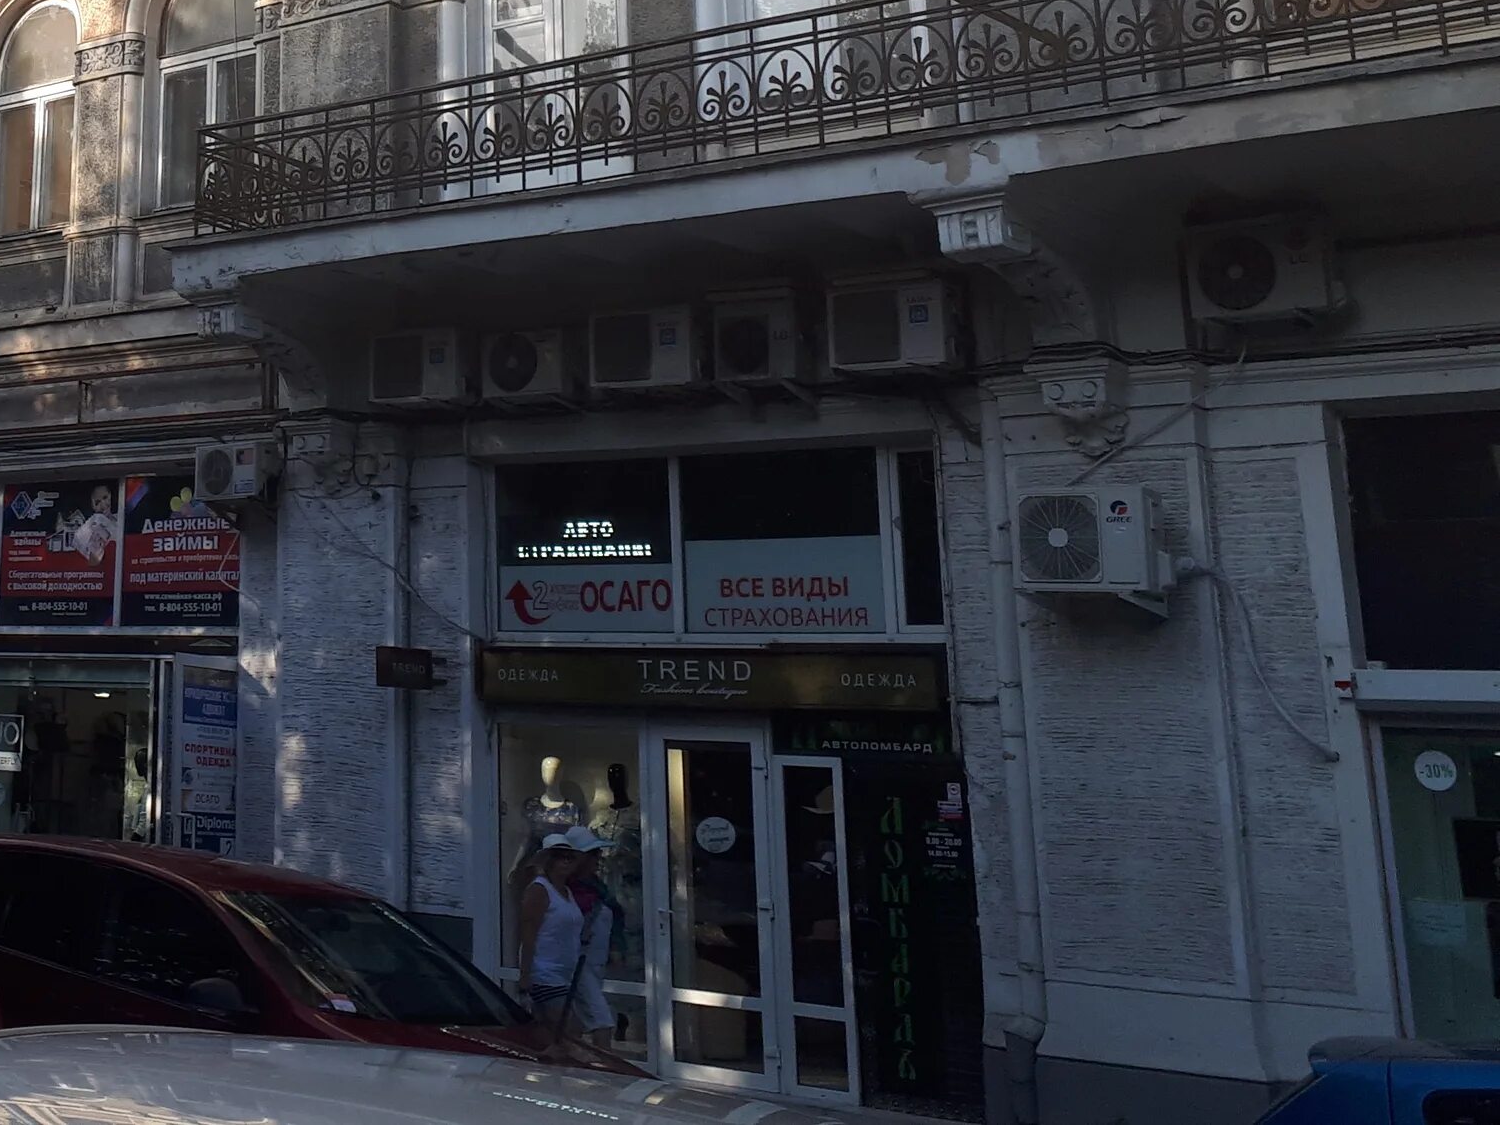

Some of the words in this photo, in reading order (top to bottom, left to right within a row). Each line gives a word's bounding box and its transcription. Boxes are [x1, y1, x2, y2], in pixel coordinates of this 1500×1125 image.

[1105, 515, 1133, 524] GREE
[562, 519, 616, 540] АВТО
[152, 532, 220, 553] займы
[147, 568, 204, 584] материнский
[579, 578, 672, 613] ОСАГО
[720, 578, 765, 599] ВСЕ
[771, 576, 849, 601] ВИДЫ
[159, 601, 222, 613] 8-804-555-10-01
[704, 605, 869, 629] СТРАХОВАНИЯ
[391, 662, 426, 675] TREND
[497, 668, 560, 683] ОДЕЖДА
[637, 659, 752, 682] TREND
[840, 673, 918, 688] ОДЕЖДА
[184, 742, 237, 757] СПОРТИВНА
[821, 740, 933, 754] АВТОЛОМБАРД
